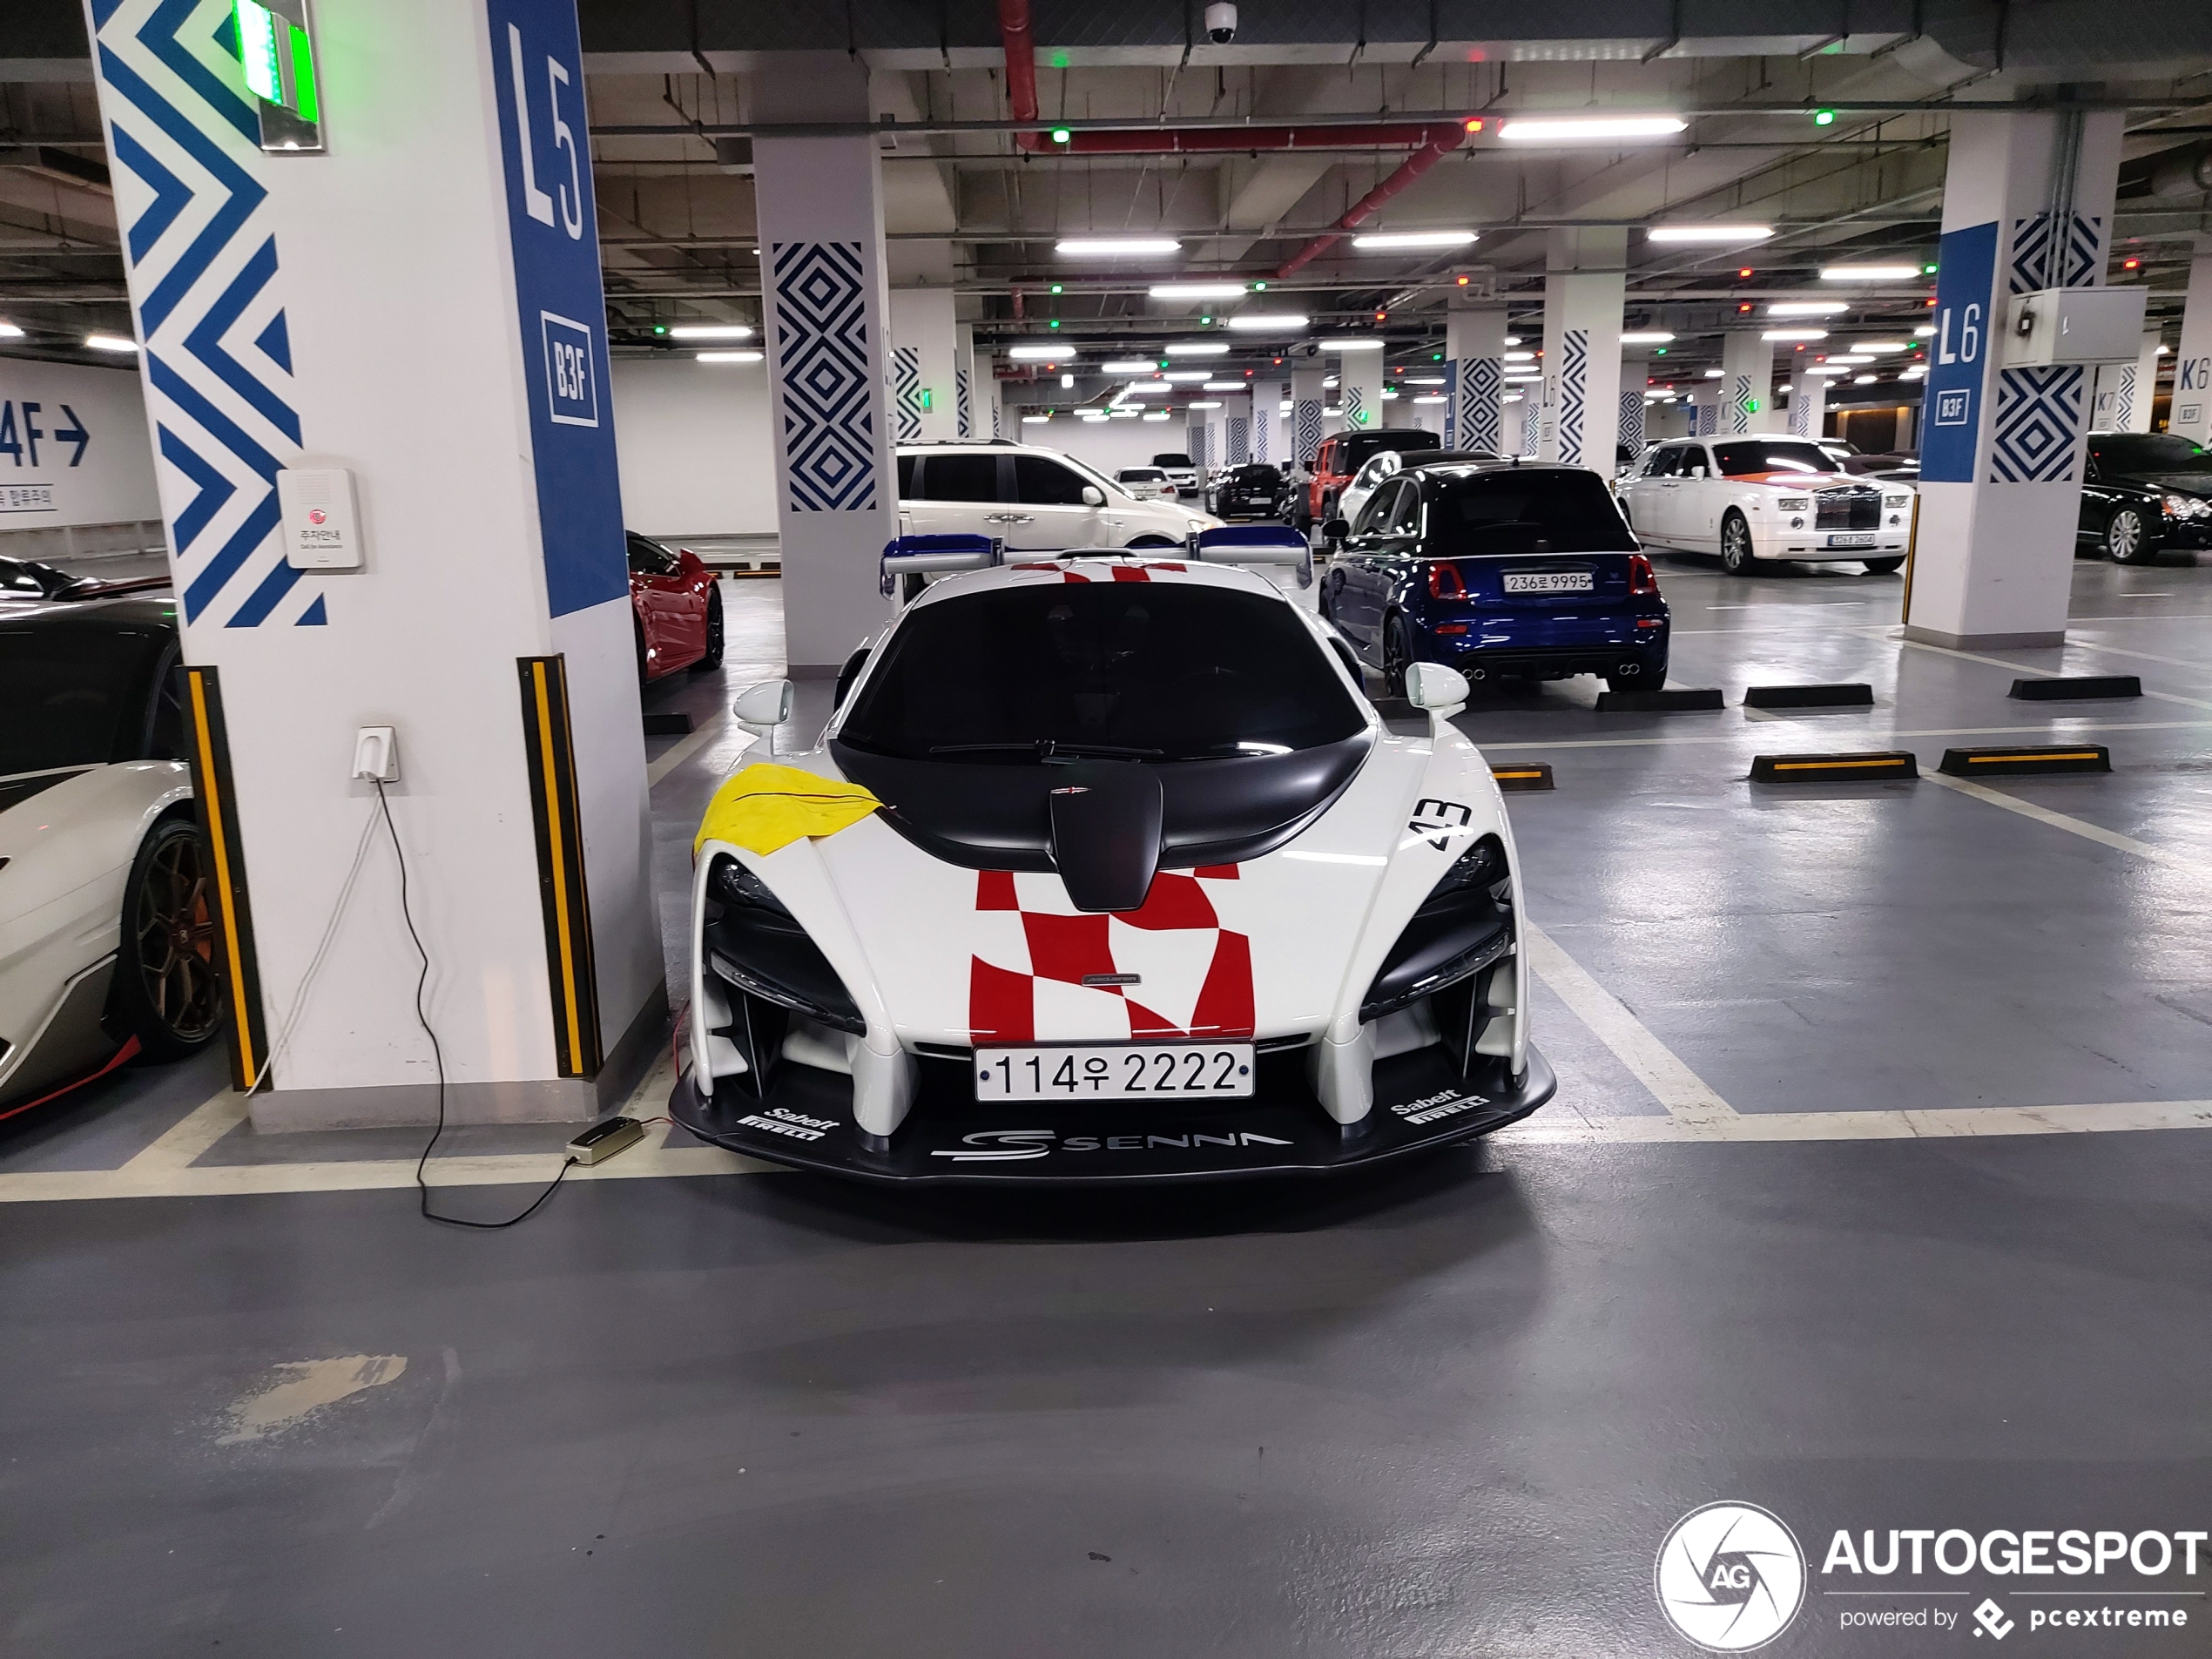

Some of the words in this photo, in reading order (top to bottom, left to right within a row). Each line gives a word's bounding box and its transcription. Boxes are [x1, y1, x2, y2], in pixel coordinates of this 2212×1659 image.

[508, 22, 583, 241] L5
[1938, 303, 1980, 365] L6
[553, 341, 585, 401] B3F
[2181, 357, 2211, 390] K6
[1941, 397, 1964, 418] B3F
[2097, 392, 2115, 411] K7
[0, 400, 43, 467] 4F
[300, 530, 341, 541] 주차안내
[1551, 575, 1588, 589] 9995
[995, 1055, 1109, 1093] 114우
[1124, 1051, 1236, 1092] 2222
[1390, 1089, 1462, 1115] Sabelt
[1403, 1096, 1491, 1125] PIRELLI
[736, 1115, 826, 1141] PIRELLI
[764, 1108, 840, 1130] Sabelt
[1061, 1133, 1295, 1150] SENNA
